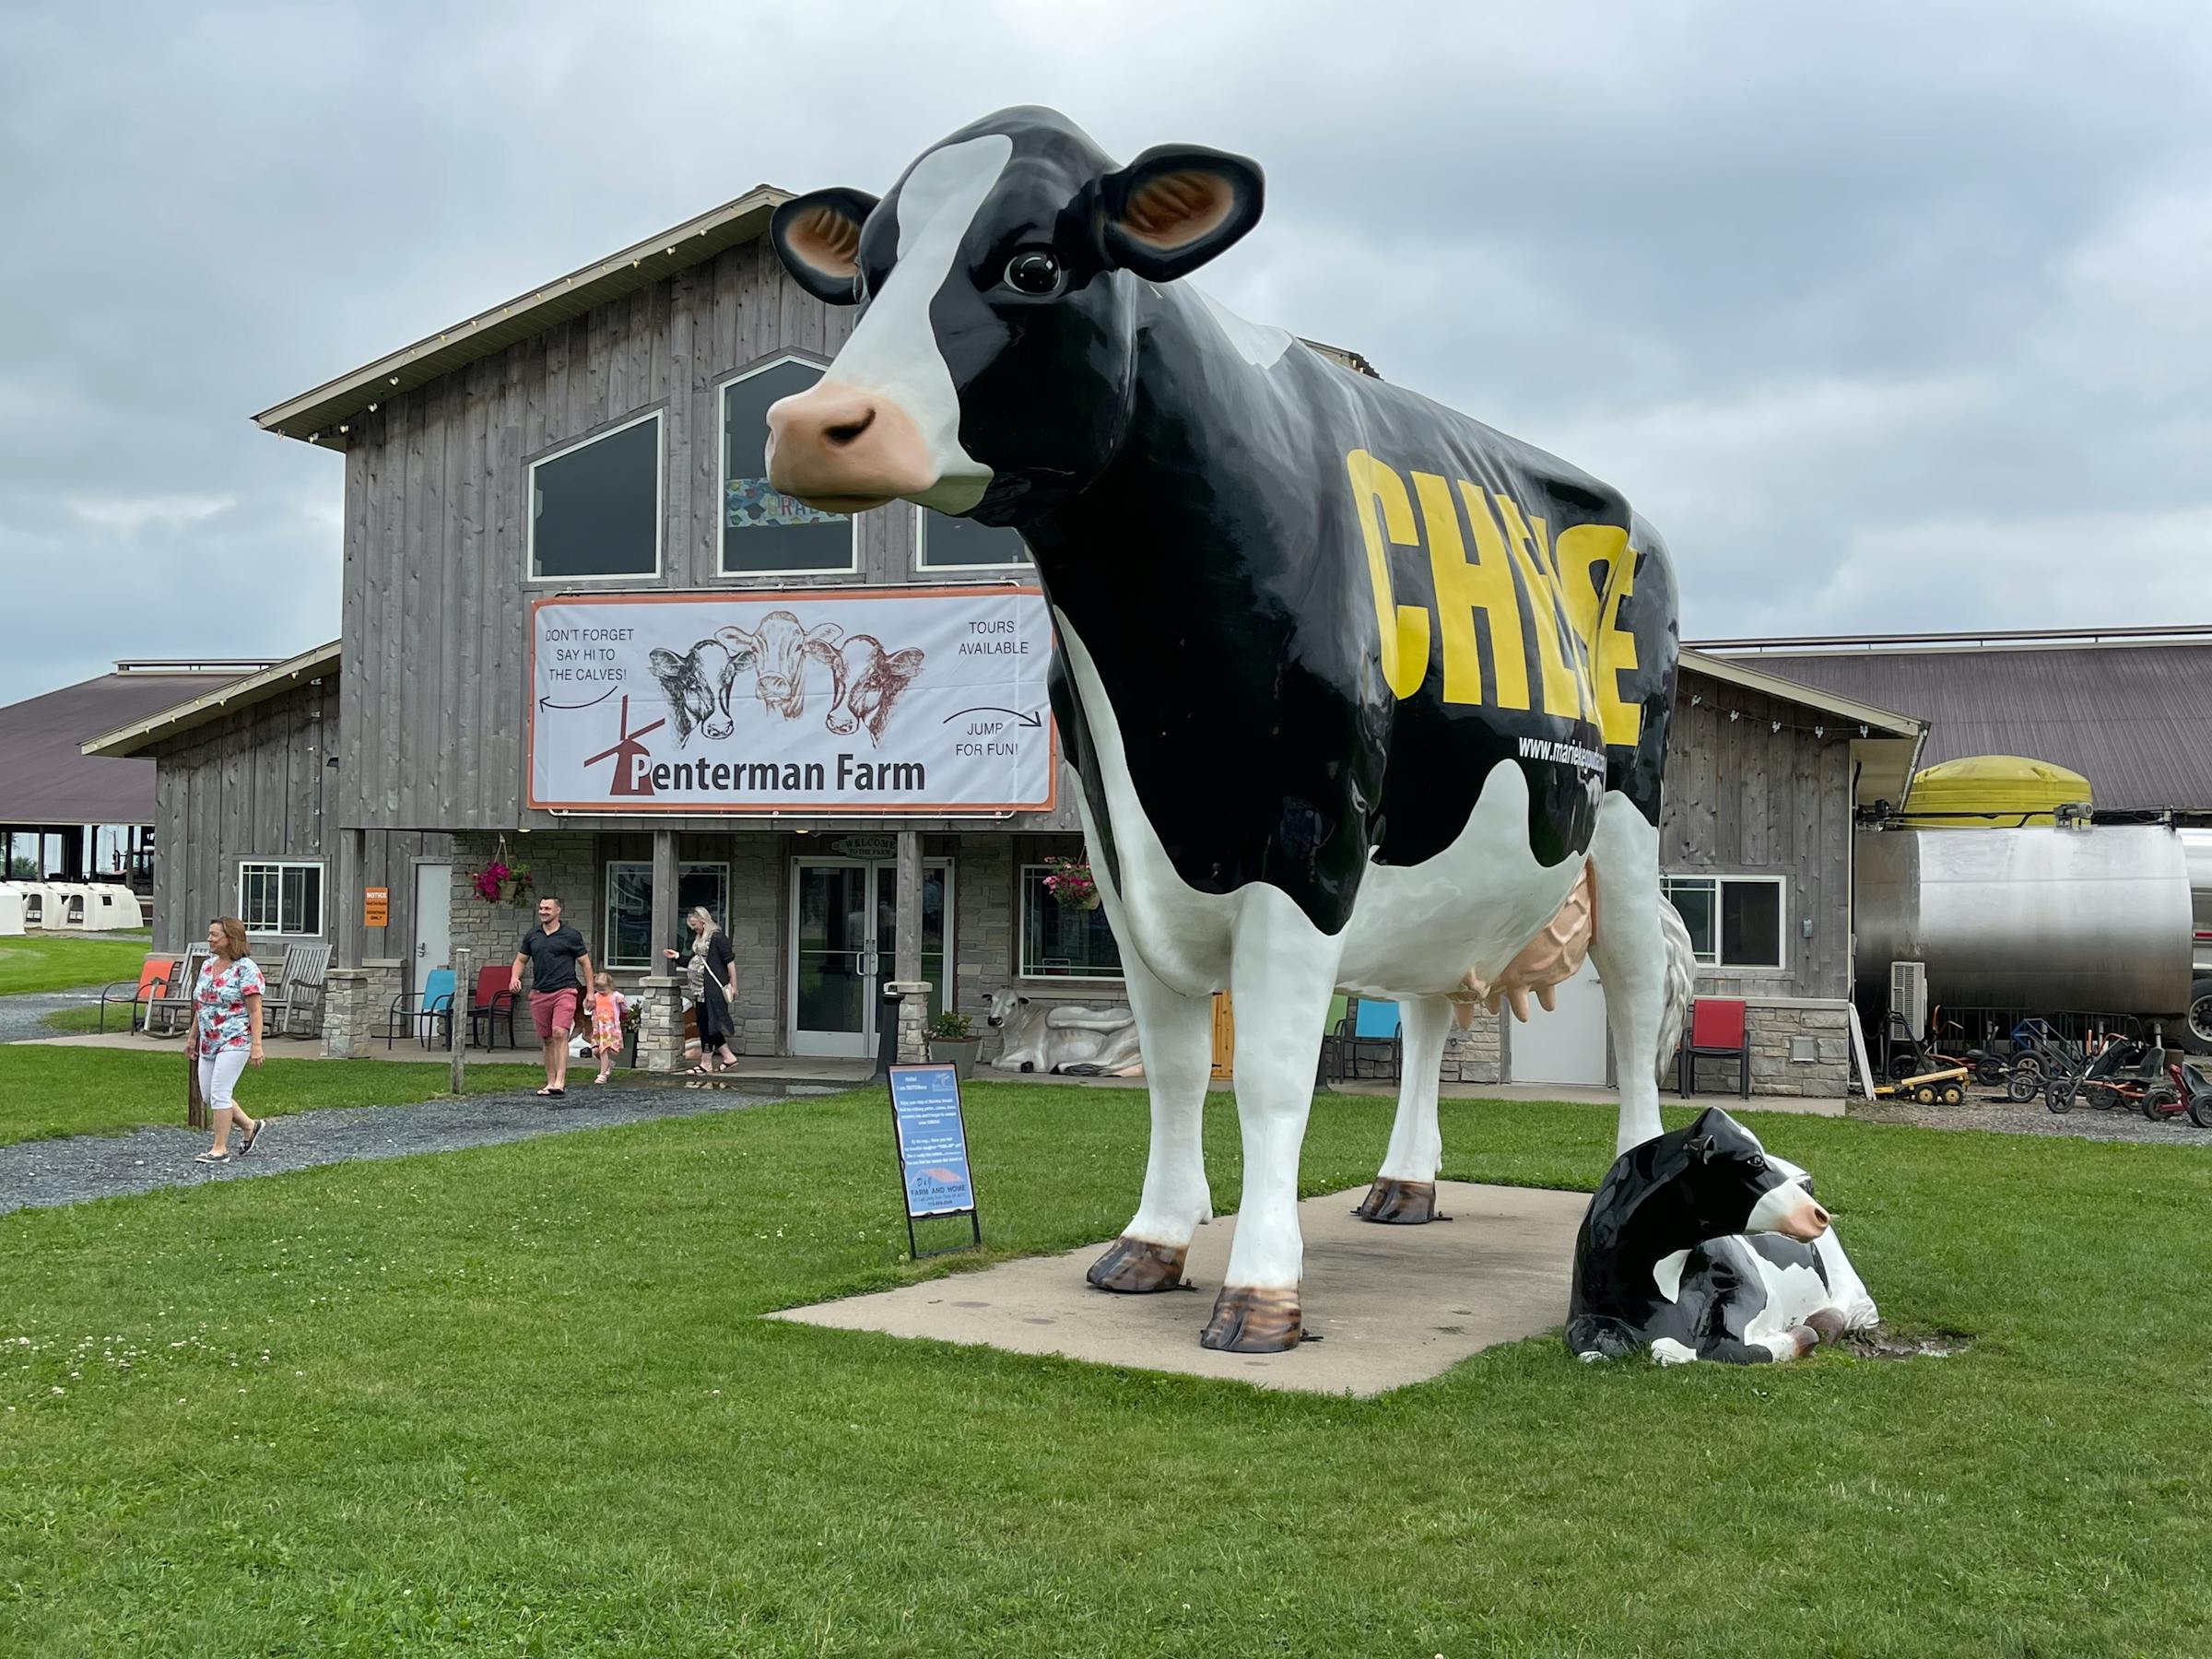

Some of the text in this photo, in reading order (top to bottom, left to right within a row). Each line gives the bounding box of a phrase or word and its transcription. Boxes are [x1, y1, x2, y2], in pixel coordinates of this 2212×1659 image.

[968, 620, 1015, 634] TOURS
[546, 629, 634, 641] DON'T FORGET
[556, 648, 616, 661] SAY HI TO
[959, 641, 1030, 655] AVAILABLE
[549, 668, 627, 681] THE CALVES!
[967, 723, 1004, 735] JUMP
[956, 743, 1018, 756] FOR FUN!
[630, 753, 925, 791] Penterman Farm
[845, 838, 896, 849] WELCOME
[911, 1184, 967, 1196] FARM AND HOME
